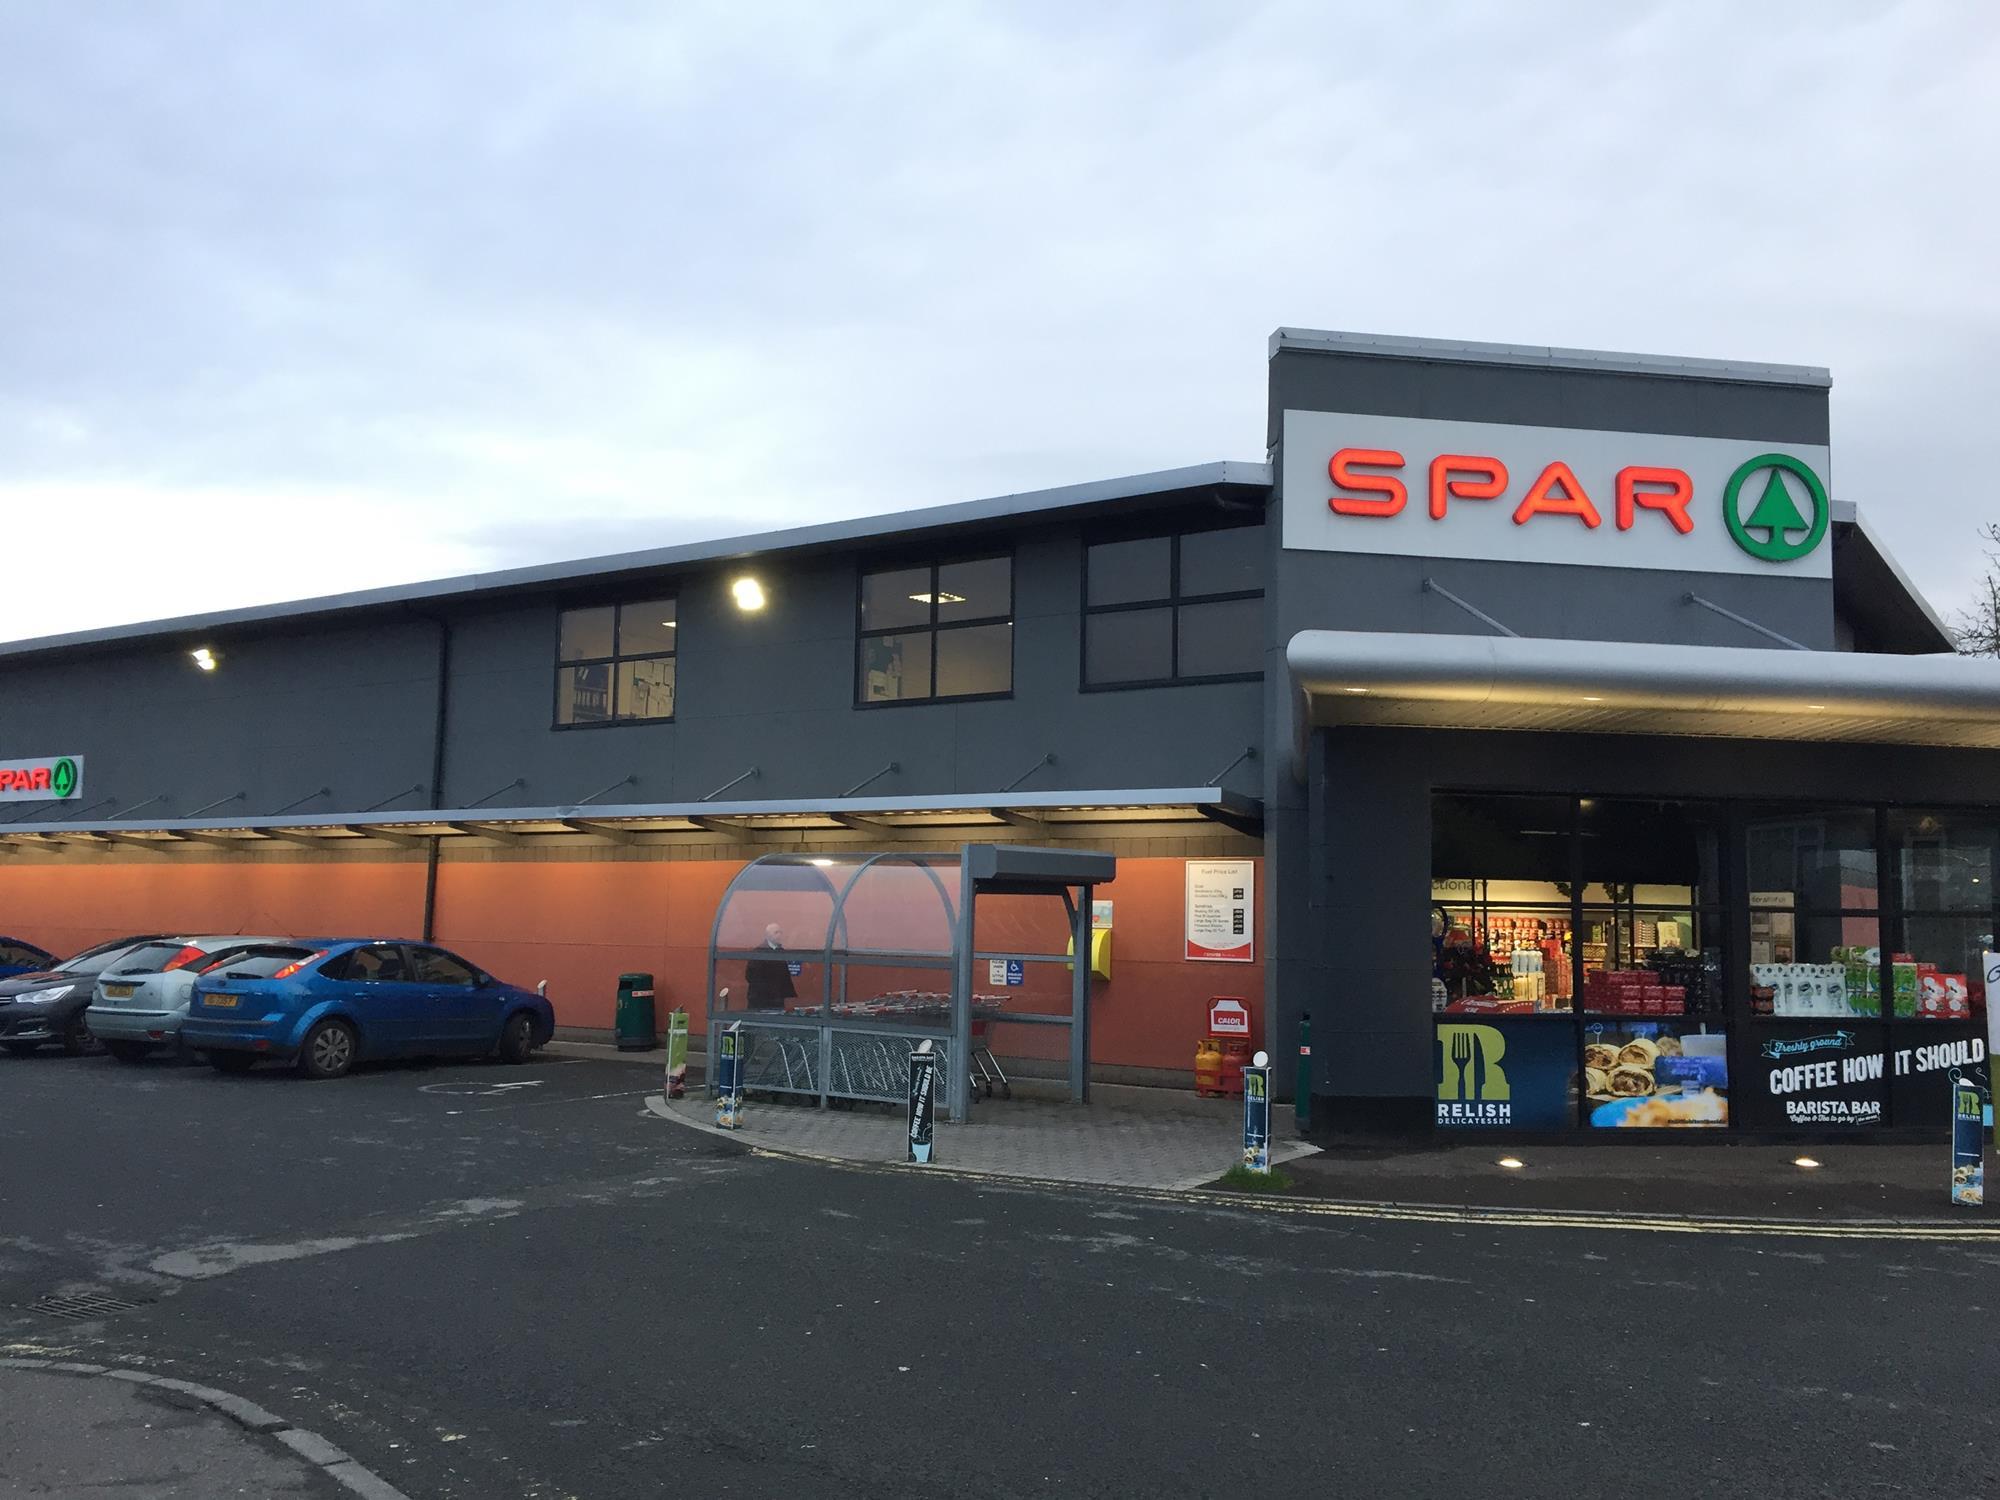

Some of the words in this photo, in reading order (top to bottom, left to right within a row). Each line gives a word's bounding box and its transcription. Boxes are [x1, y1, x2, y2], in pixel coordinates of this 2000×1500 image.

[1328, 447, 1694, 535] SPAR
[1217, 1017, 1241, 1026] CALOR
[1774, 1040, 1809, 1053] Freshly
[1810, 1037, 1843, 1051] ground
[1769, 1060, 1838, 1095] COFFEE
[1842, 1053, 1885, 1084] HOW
[1894, 1049, 1913, 1076] IT
[1915, 1037, 1985, 1073] SHOULD
[1437, 1103, 1511, 1117] RELISH
[1786, 1101, 1849, 1115] BARISTA
[1851, 1101, 1881, 1115] BAR
[1437, 1117, 1511, 1125] DELICATESSEN
